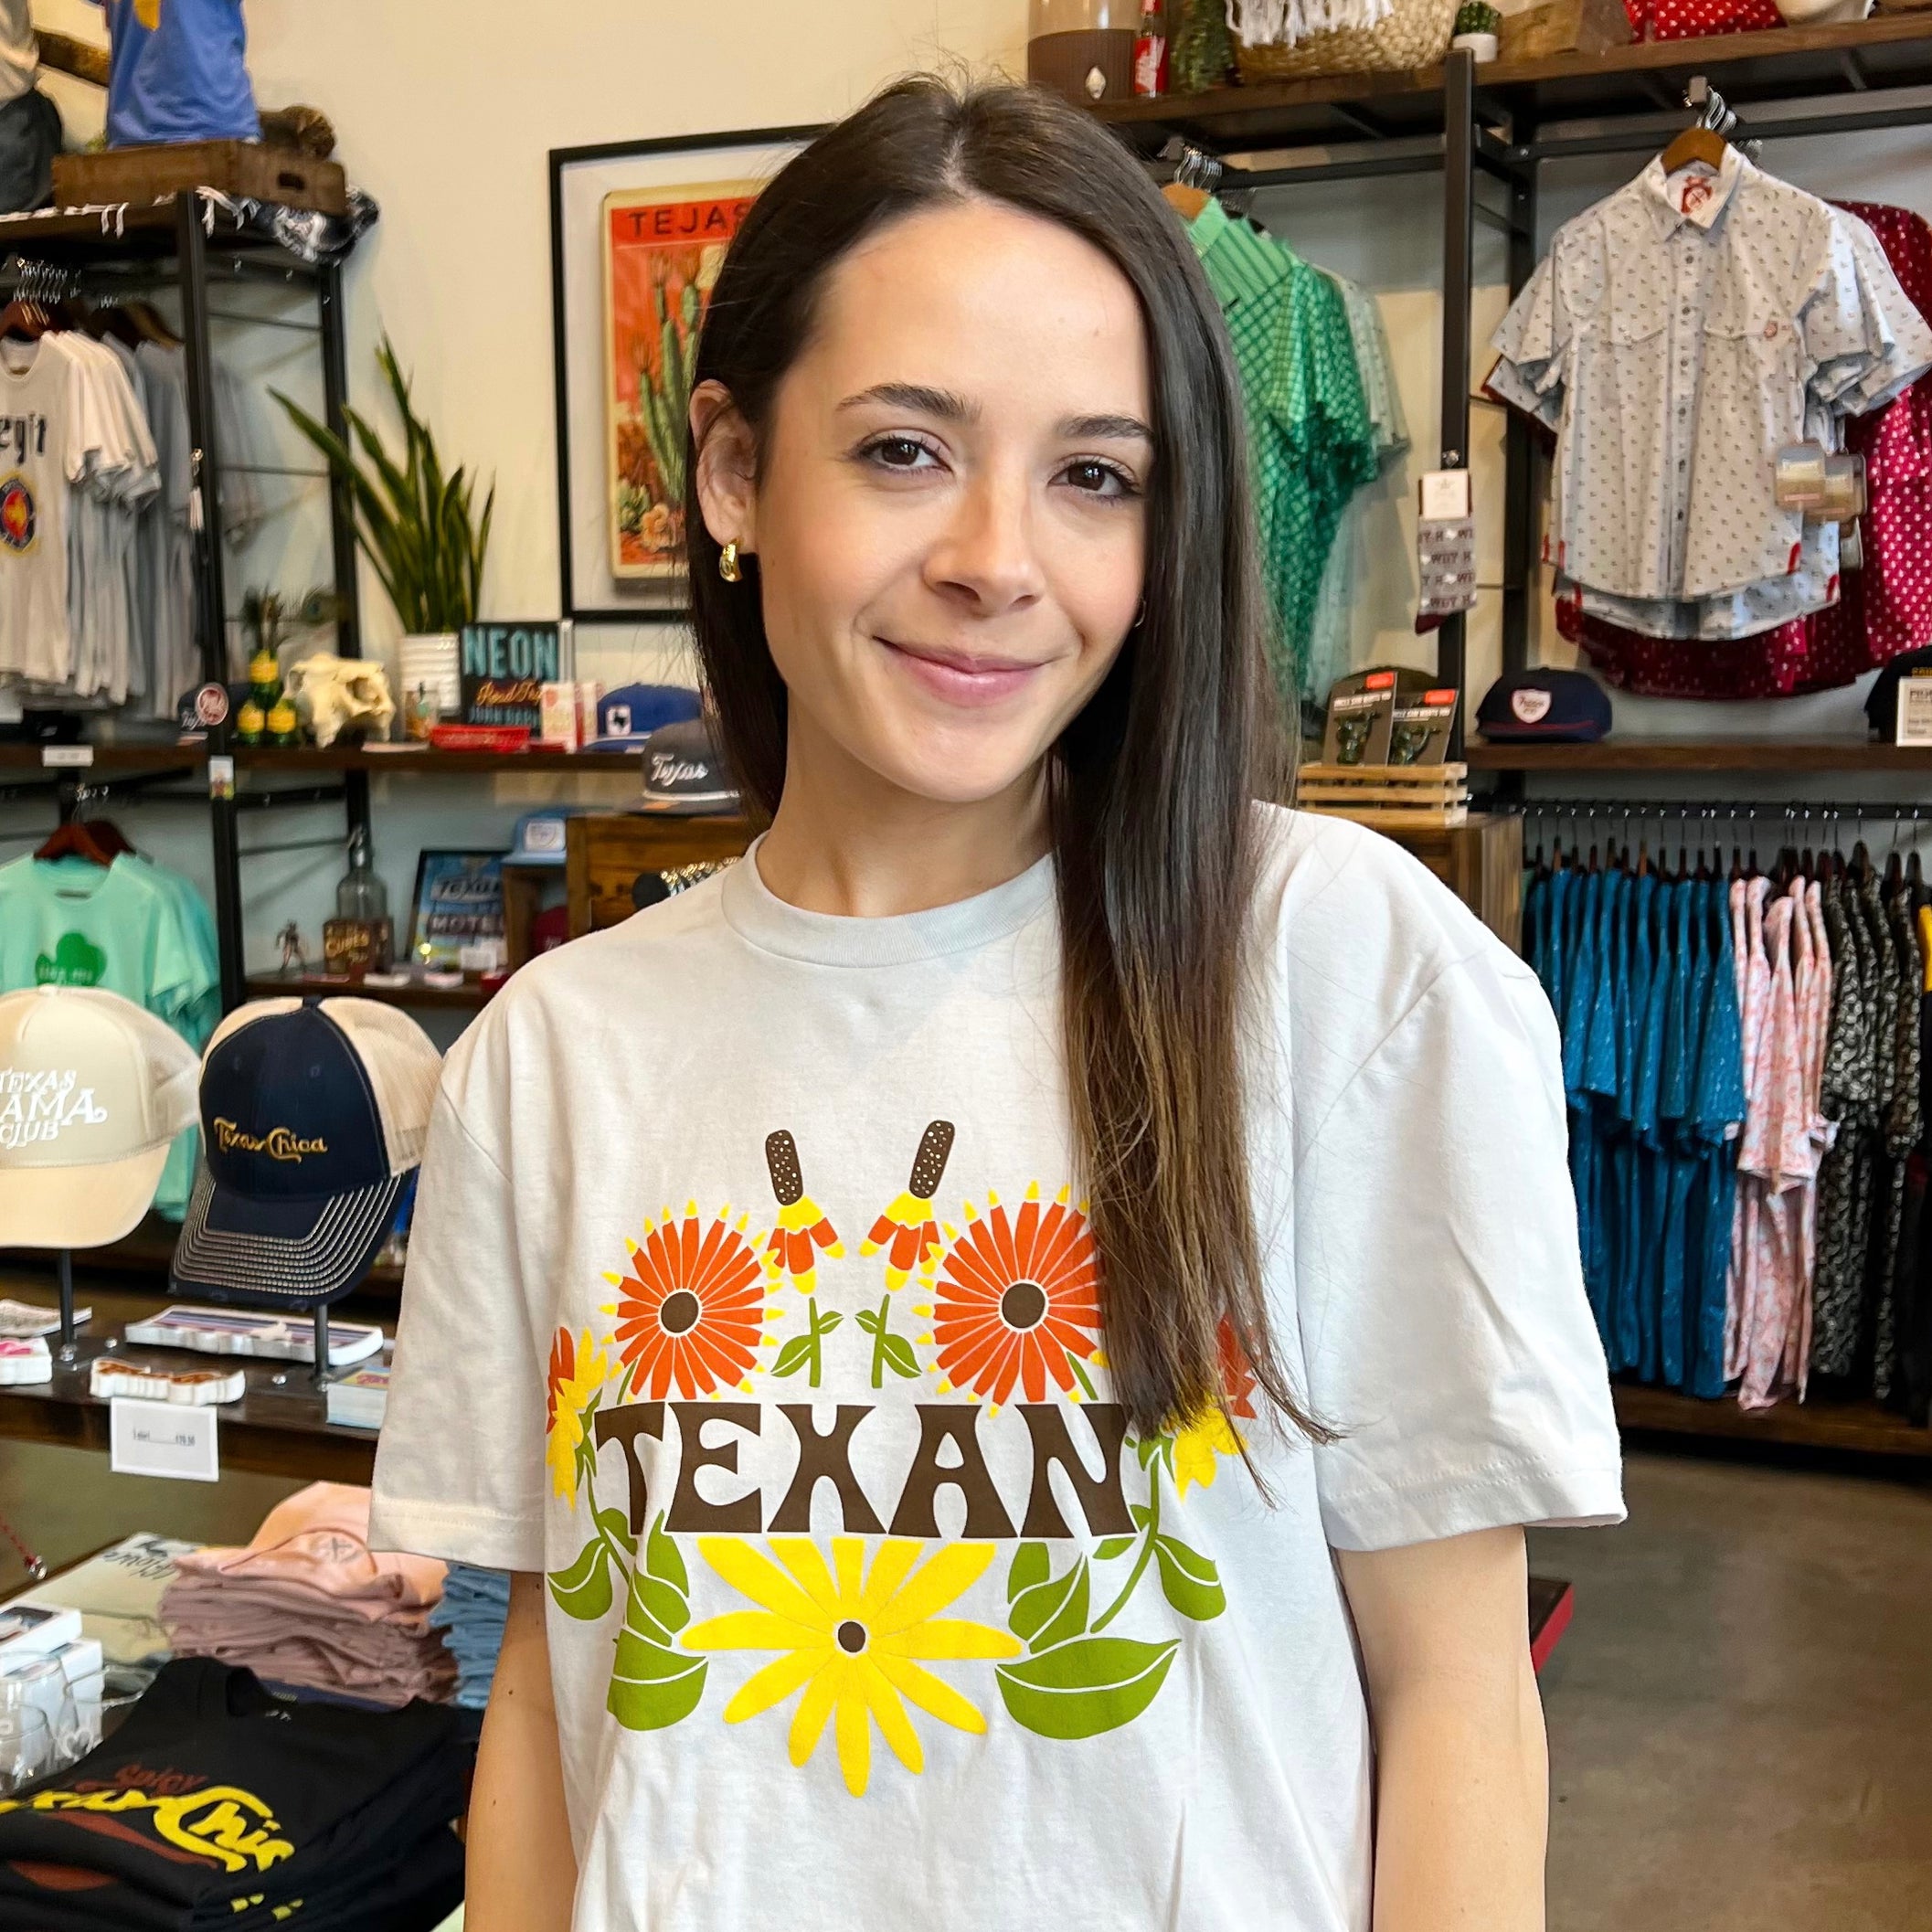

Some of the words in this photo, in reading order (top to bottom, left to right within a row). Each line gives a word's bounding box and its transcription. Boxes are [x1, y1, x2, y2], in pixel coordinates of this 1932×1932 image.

[462, 626, 558, 682] NEON
[0, 1066, 77, 1096] TEXAS
[0, 1088, 108, 1126] AMA
[0, 1120, 59, 1150] CLUB
[265, 1126, 328, 1164] Chica
[594, 1402, 1138, 1538] TEXAN
